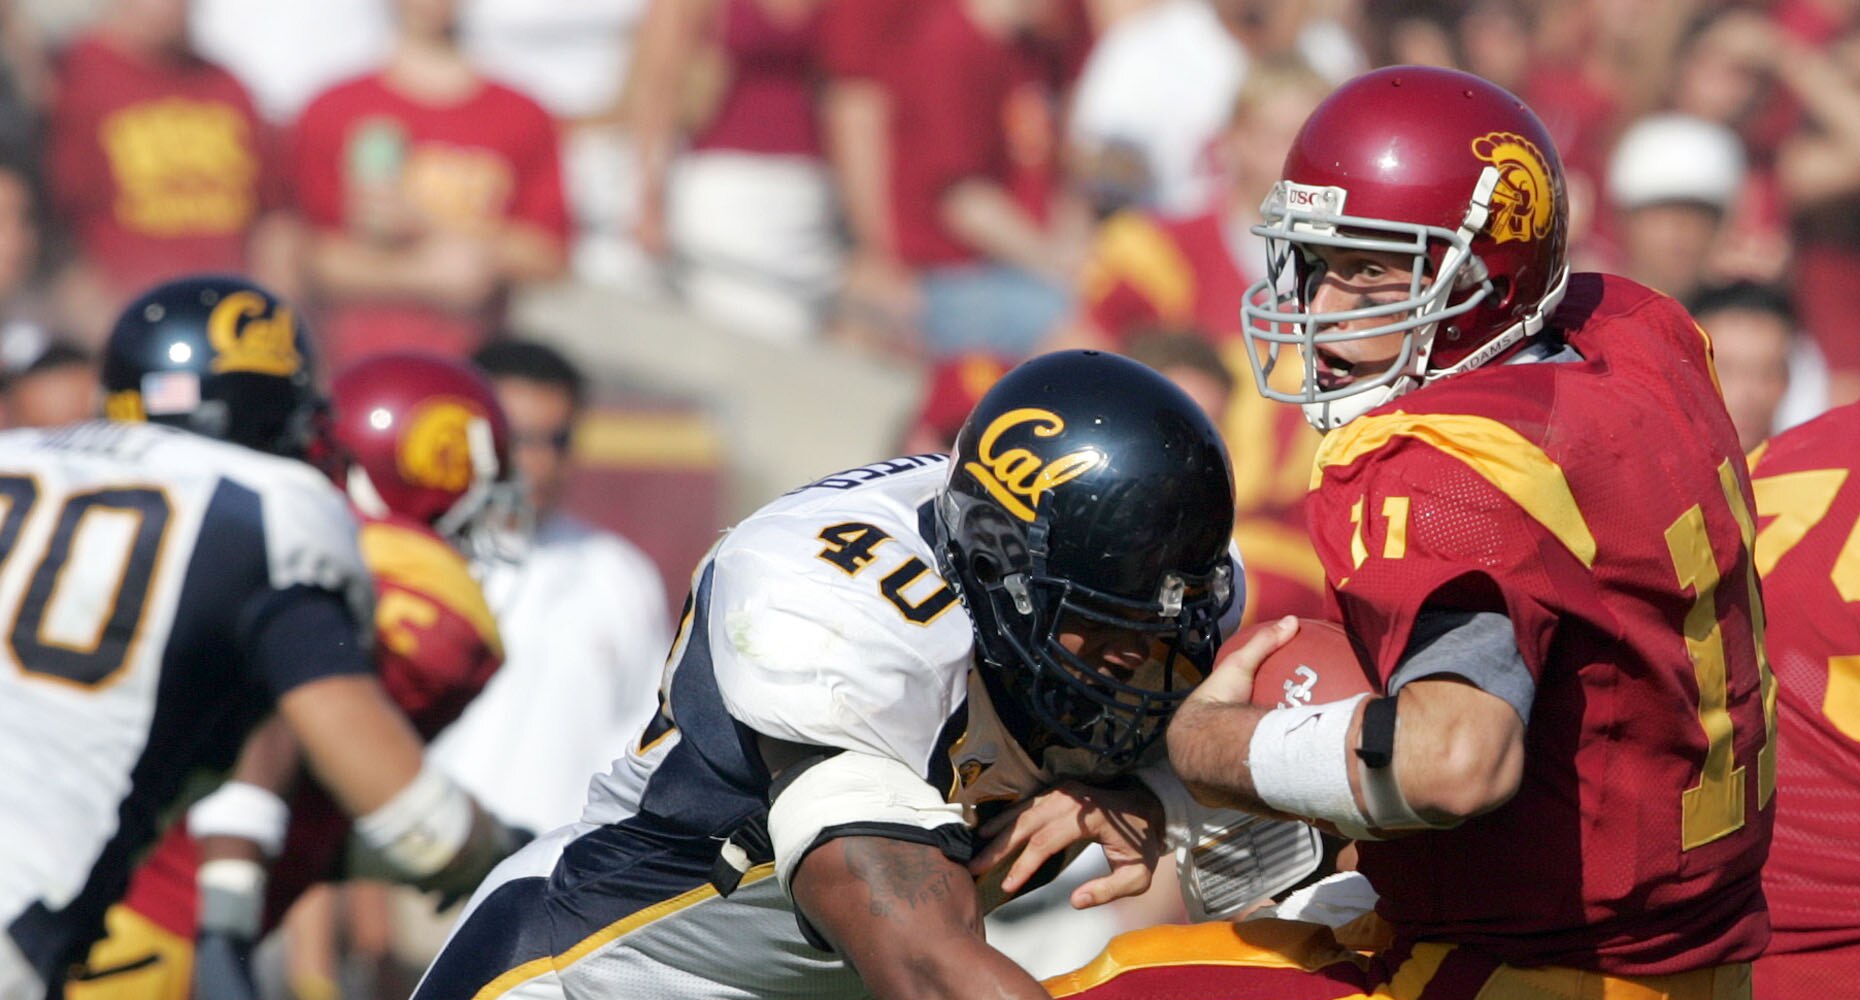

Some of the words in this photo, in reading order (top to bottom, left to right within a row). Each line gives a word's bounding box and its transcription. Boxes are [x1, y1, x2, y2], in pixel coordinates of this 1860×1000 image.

[207, 290, 302, 377] Cal
[1459, 335, 1512, 373] ADAMS
[964, 407, 1101, 523] Cal
[816, 521, 961, 628] 40
[1349, 493, 1411, 571] 11
